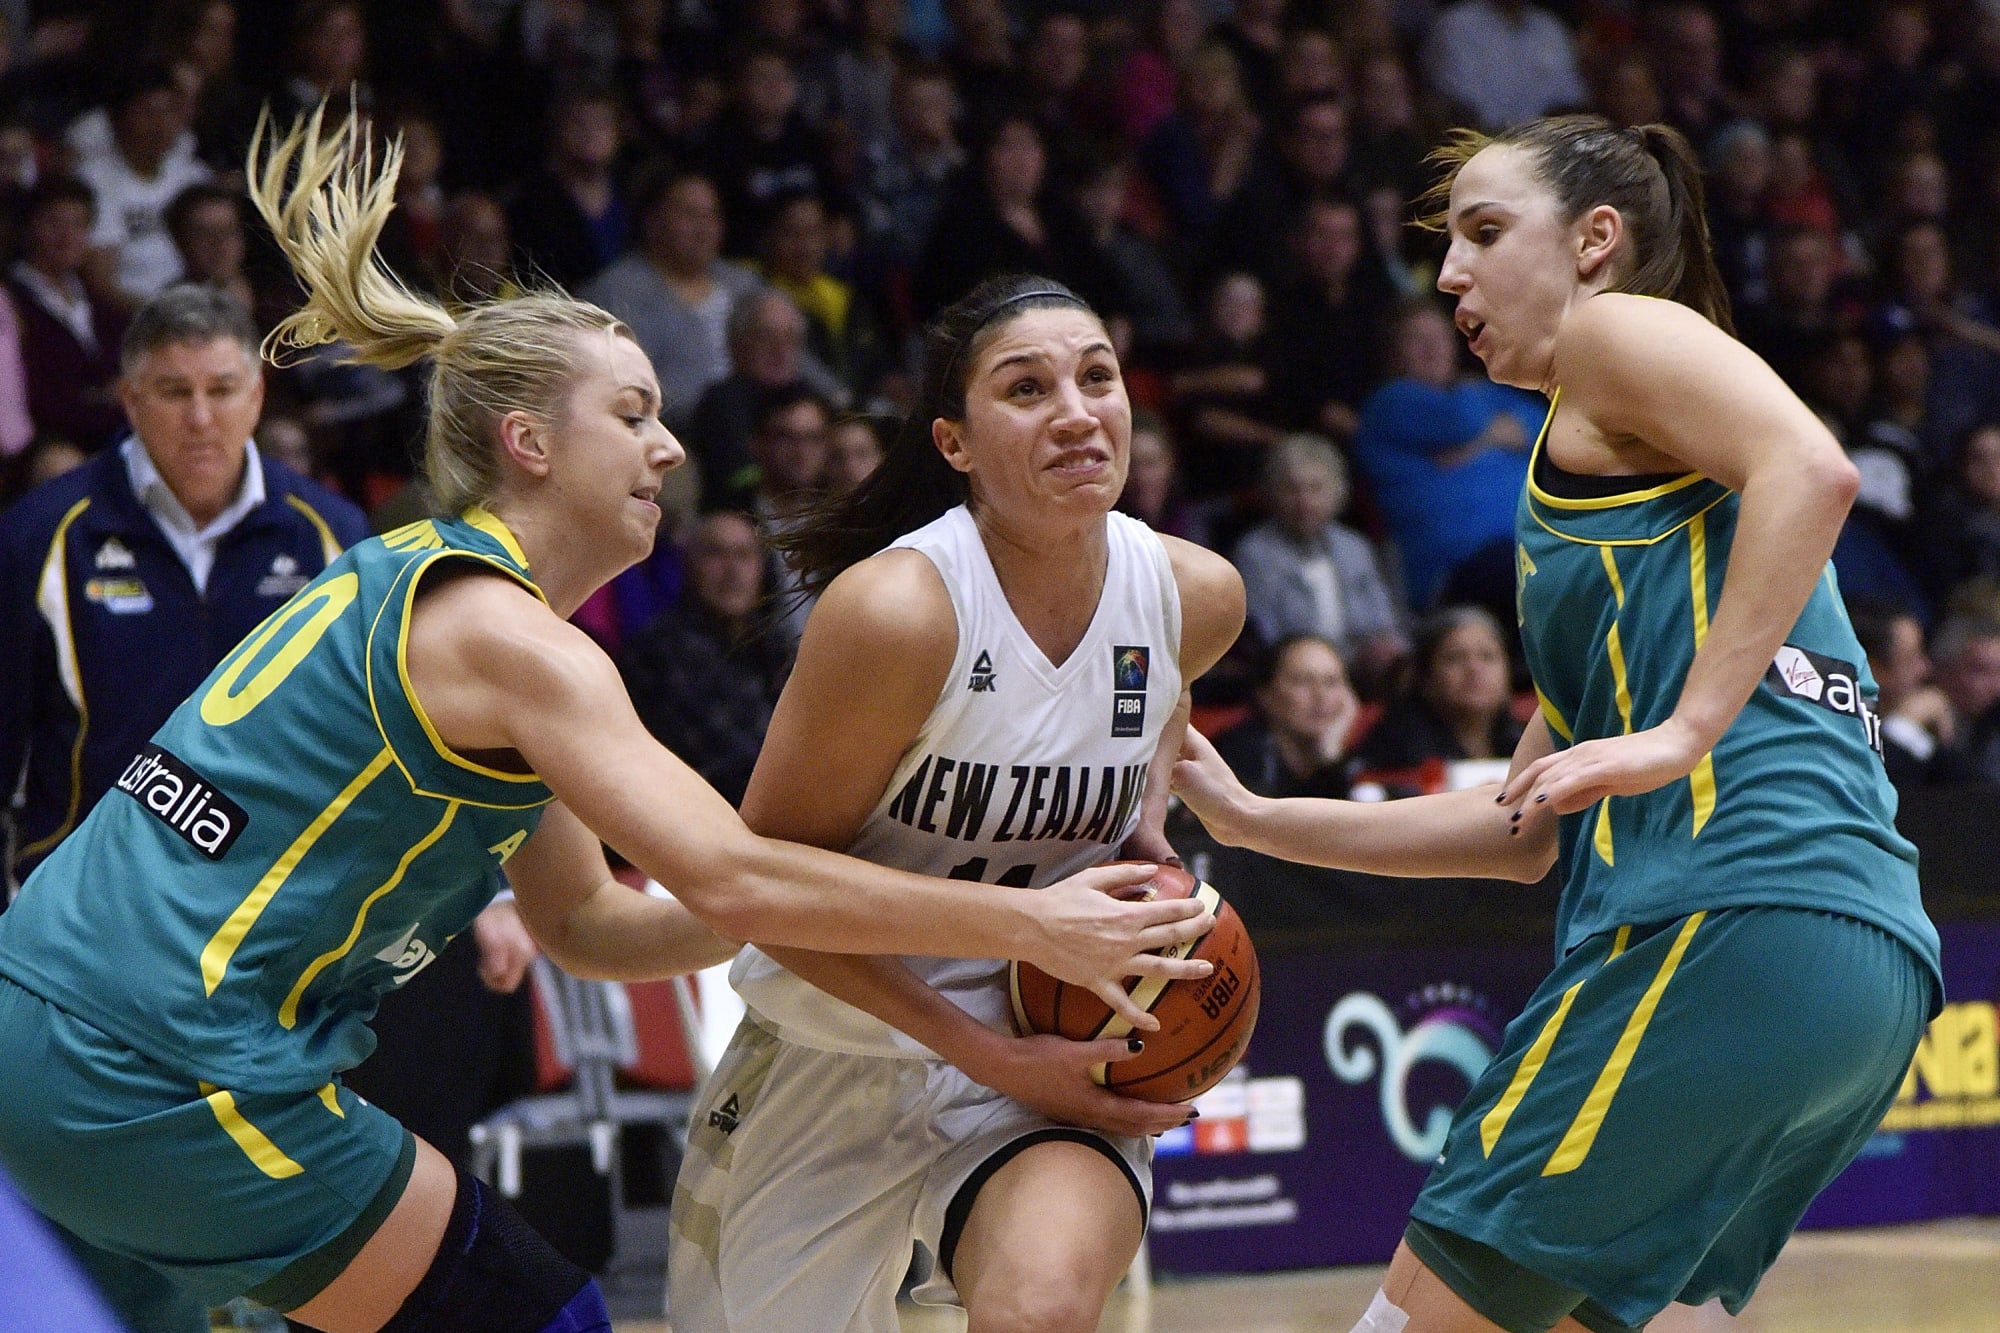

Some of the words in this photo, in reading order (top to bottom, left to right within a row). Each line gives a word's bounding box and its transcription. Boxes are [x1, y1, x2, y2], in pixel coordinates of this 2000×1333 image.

[200, 572, 358, 726] 0
[1117, 699, 1141, 714] FIBA
[117, 754, 231, 854] ustralia
[888, 754, 999, 842] NEW
[1200, 966, 1240, 1020] FIBA
